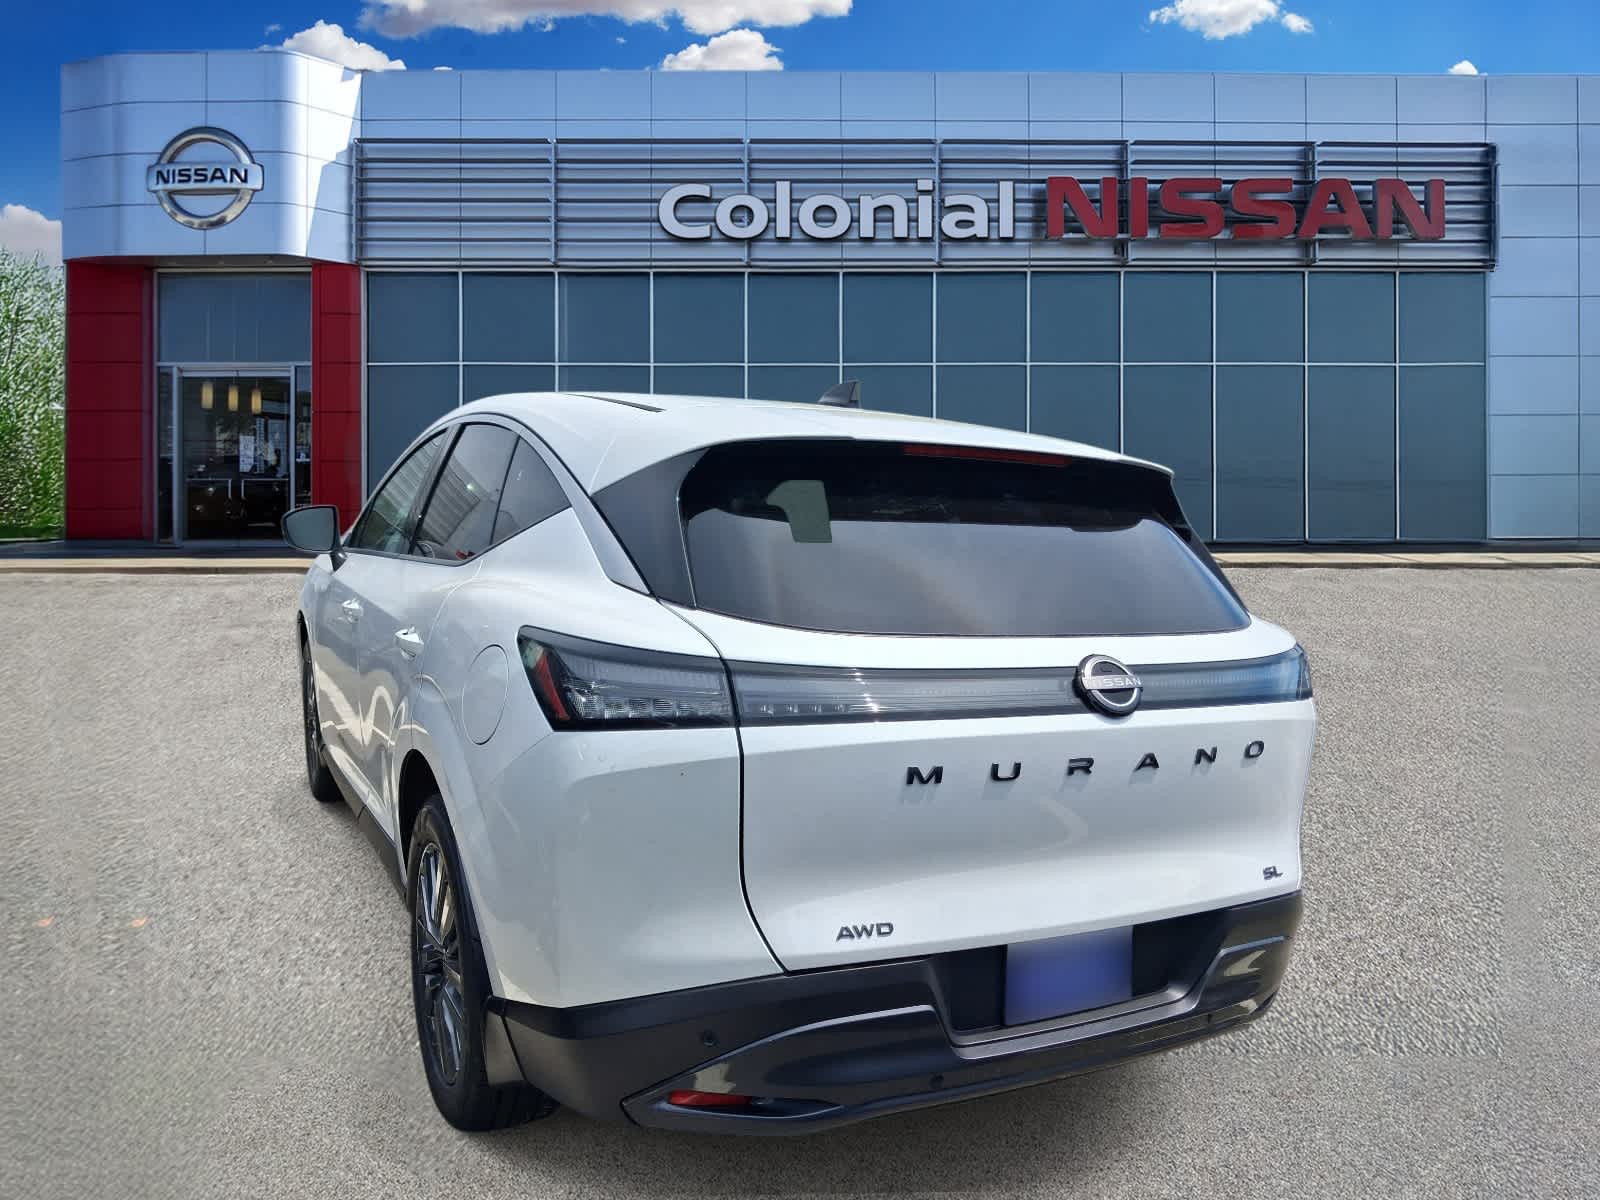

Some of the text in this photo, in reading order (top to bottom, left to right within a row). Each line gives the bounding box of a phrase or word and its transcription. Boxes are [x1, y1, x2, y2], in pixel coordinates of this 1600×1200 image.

[155, 167, 248, 185] NISSAN
[658, 176, 1446, 240] Colonial NISSAN
[1087, 676, 1141, 688] SSAN
[906, 740, 1265, 785] MURANO
[1263, 866, 1283, 880] SL
[836, 922, 894, 941] AWD
